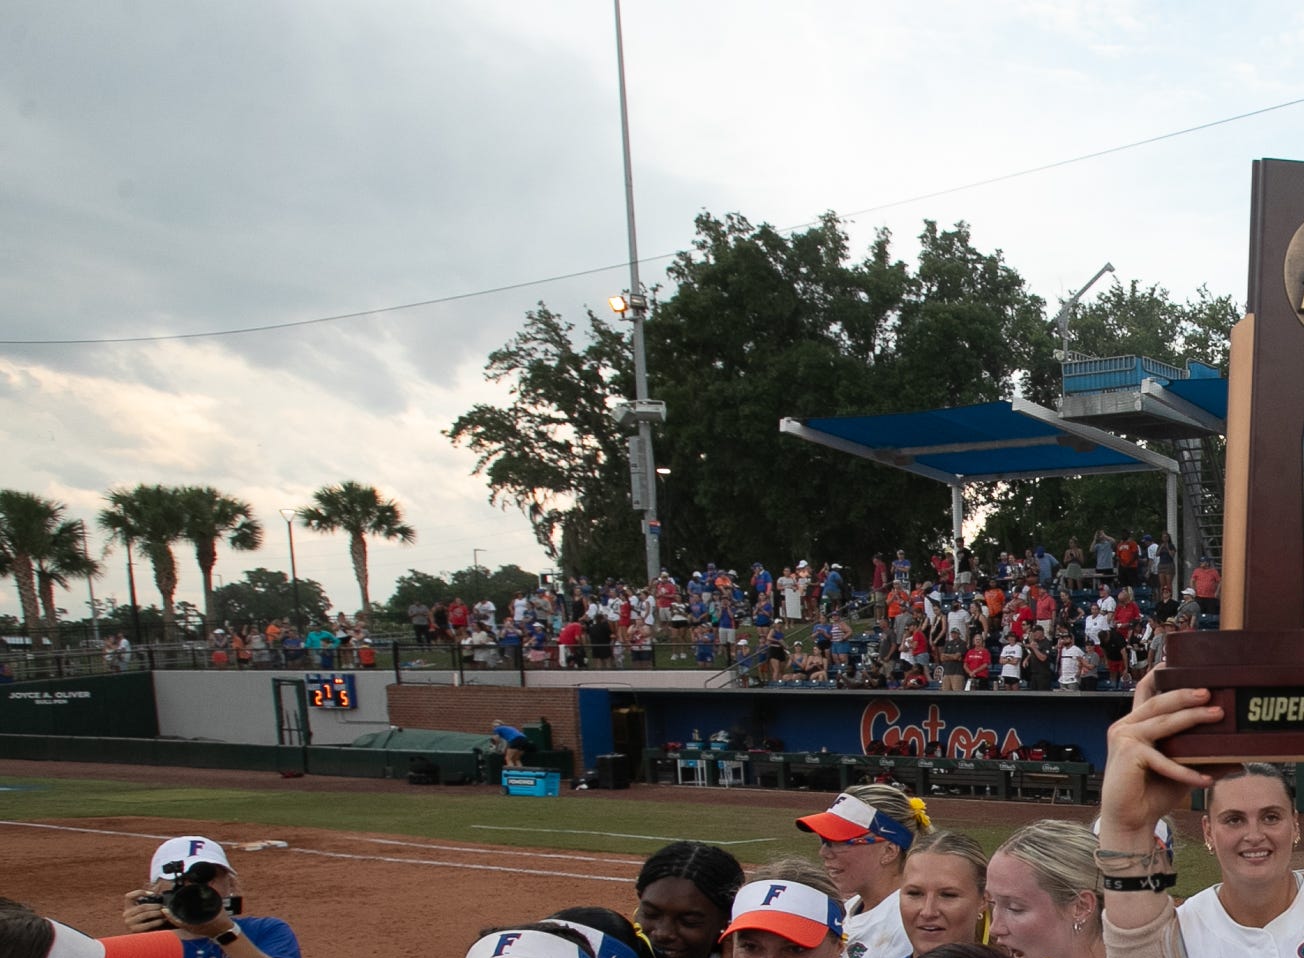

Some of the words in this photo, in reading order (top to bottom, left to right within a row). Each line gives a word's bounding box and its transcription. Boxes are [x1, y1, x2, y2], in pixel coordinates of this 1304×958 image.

[314, 690, 323, 705] 2
[340, 690, 349, 706] 5
[188, 840, 205, 857] F
[761, 884, 786, 905] F
[493, 932, 521, 957] F
